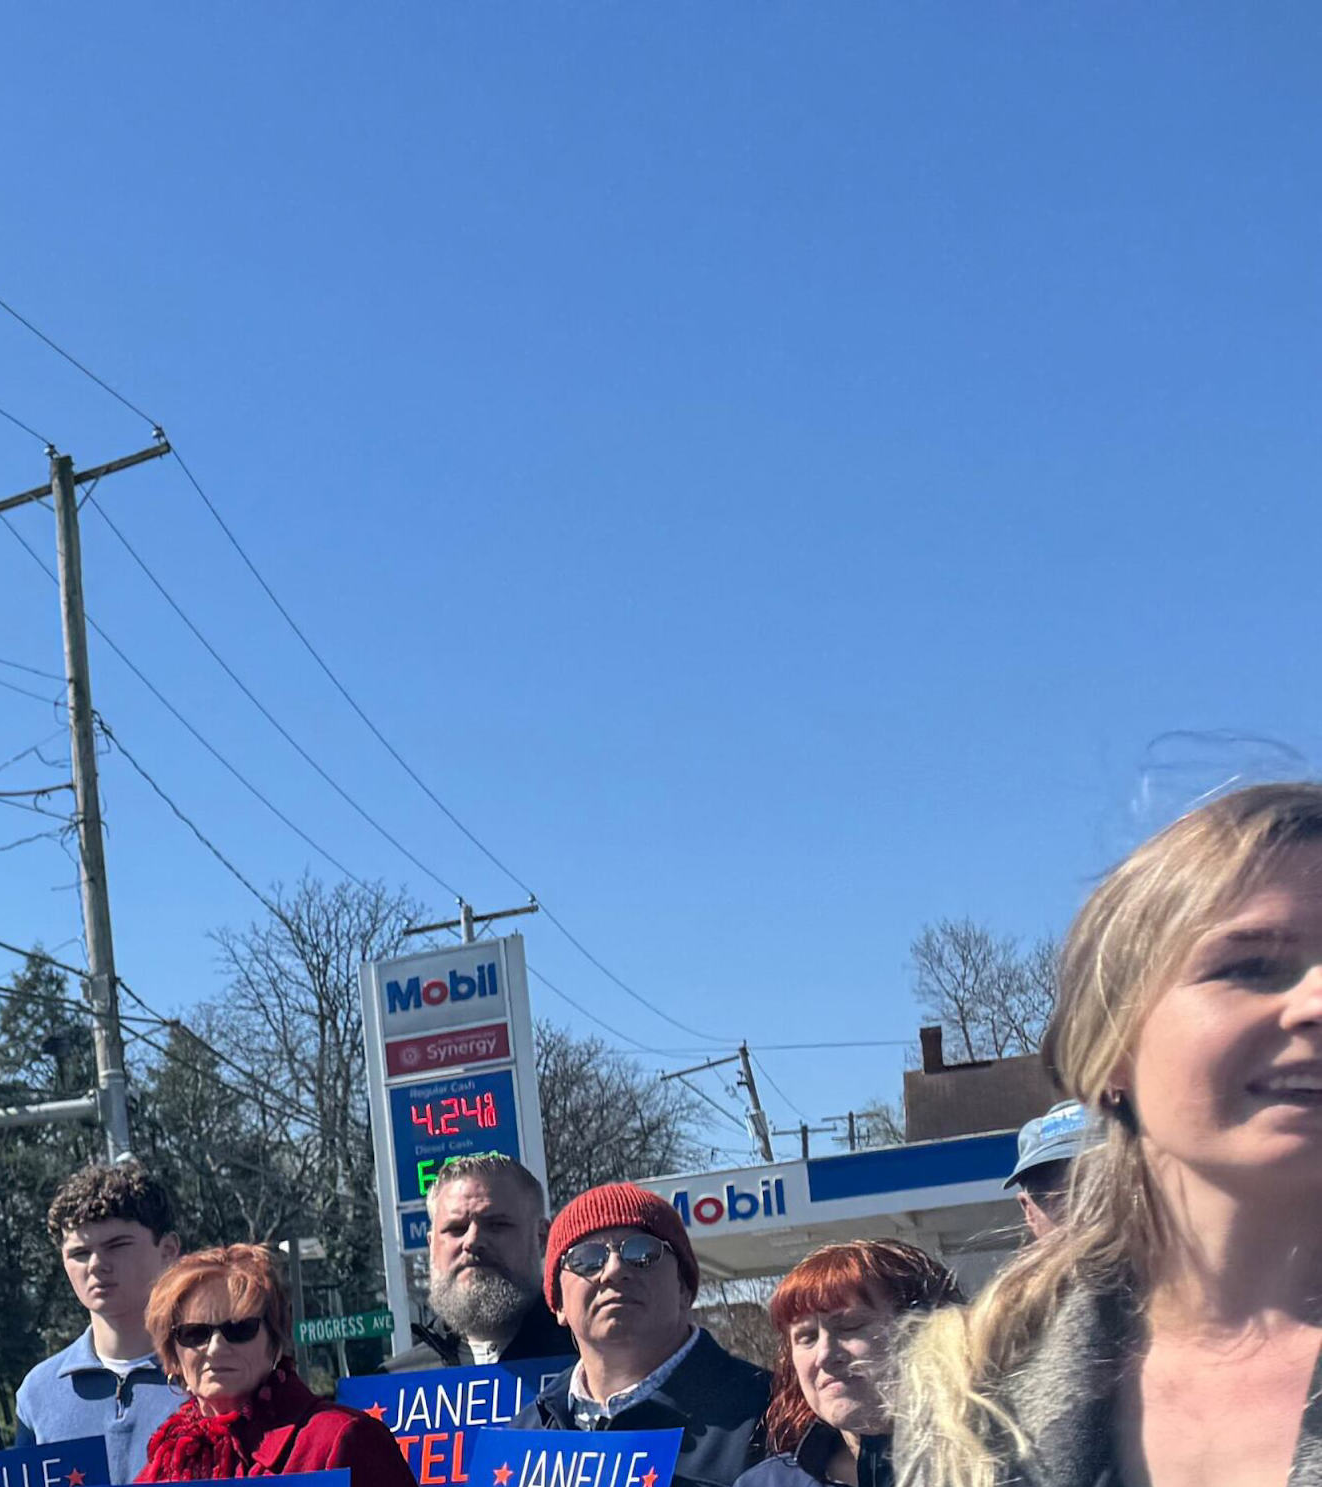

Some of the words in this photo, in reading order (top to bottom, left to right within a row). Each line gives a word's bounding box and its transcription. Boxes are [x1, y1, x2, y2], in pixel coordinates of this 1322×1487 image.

[386, 961, 498, 1014] Mobil
[427, 1037, 496, 1062] Synergy
[410, 1084, 448, 1100] Regular
[450, 1080, 475, 1094] Cash
[415, 1143, 445, 1156] Diesel
[449, 1139, 473, 1151] Cash
[299, 1315, 365, 1343] PROGRESS
[373, 1314, 392, 1330] AVE
